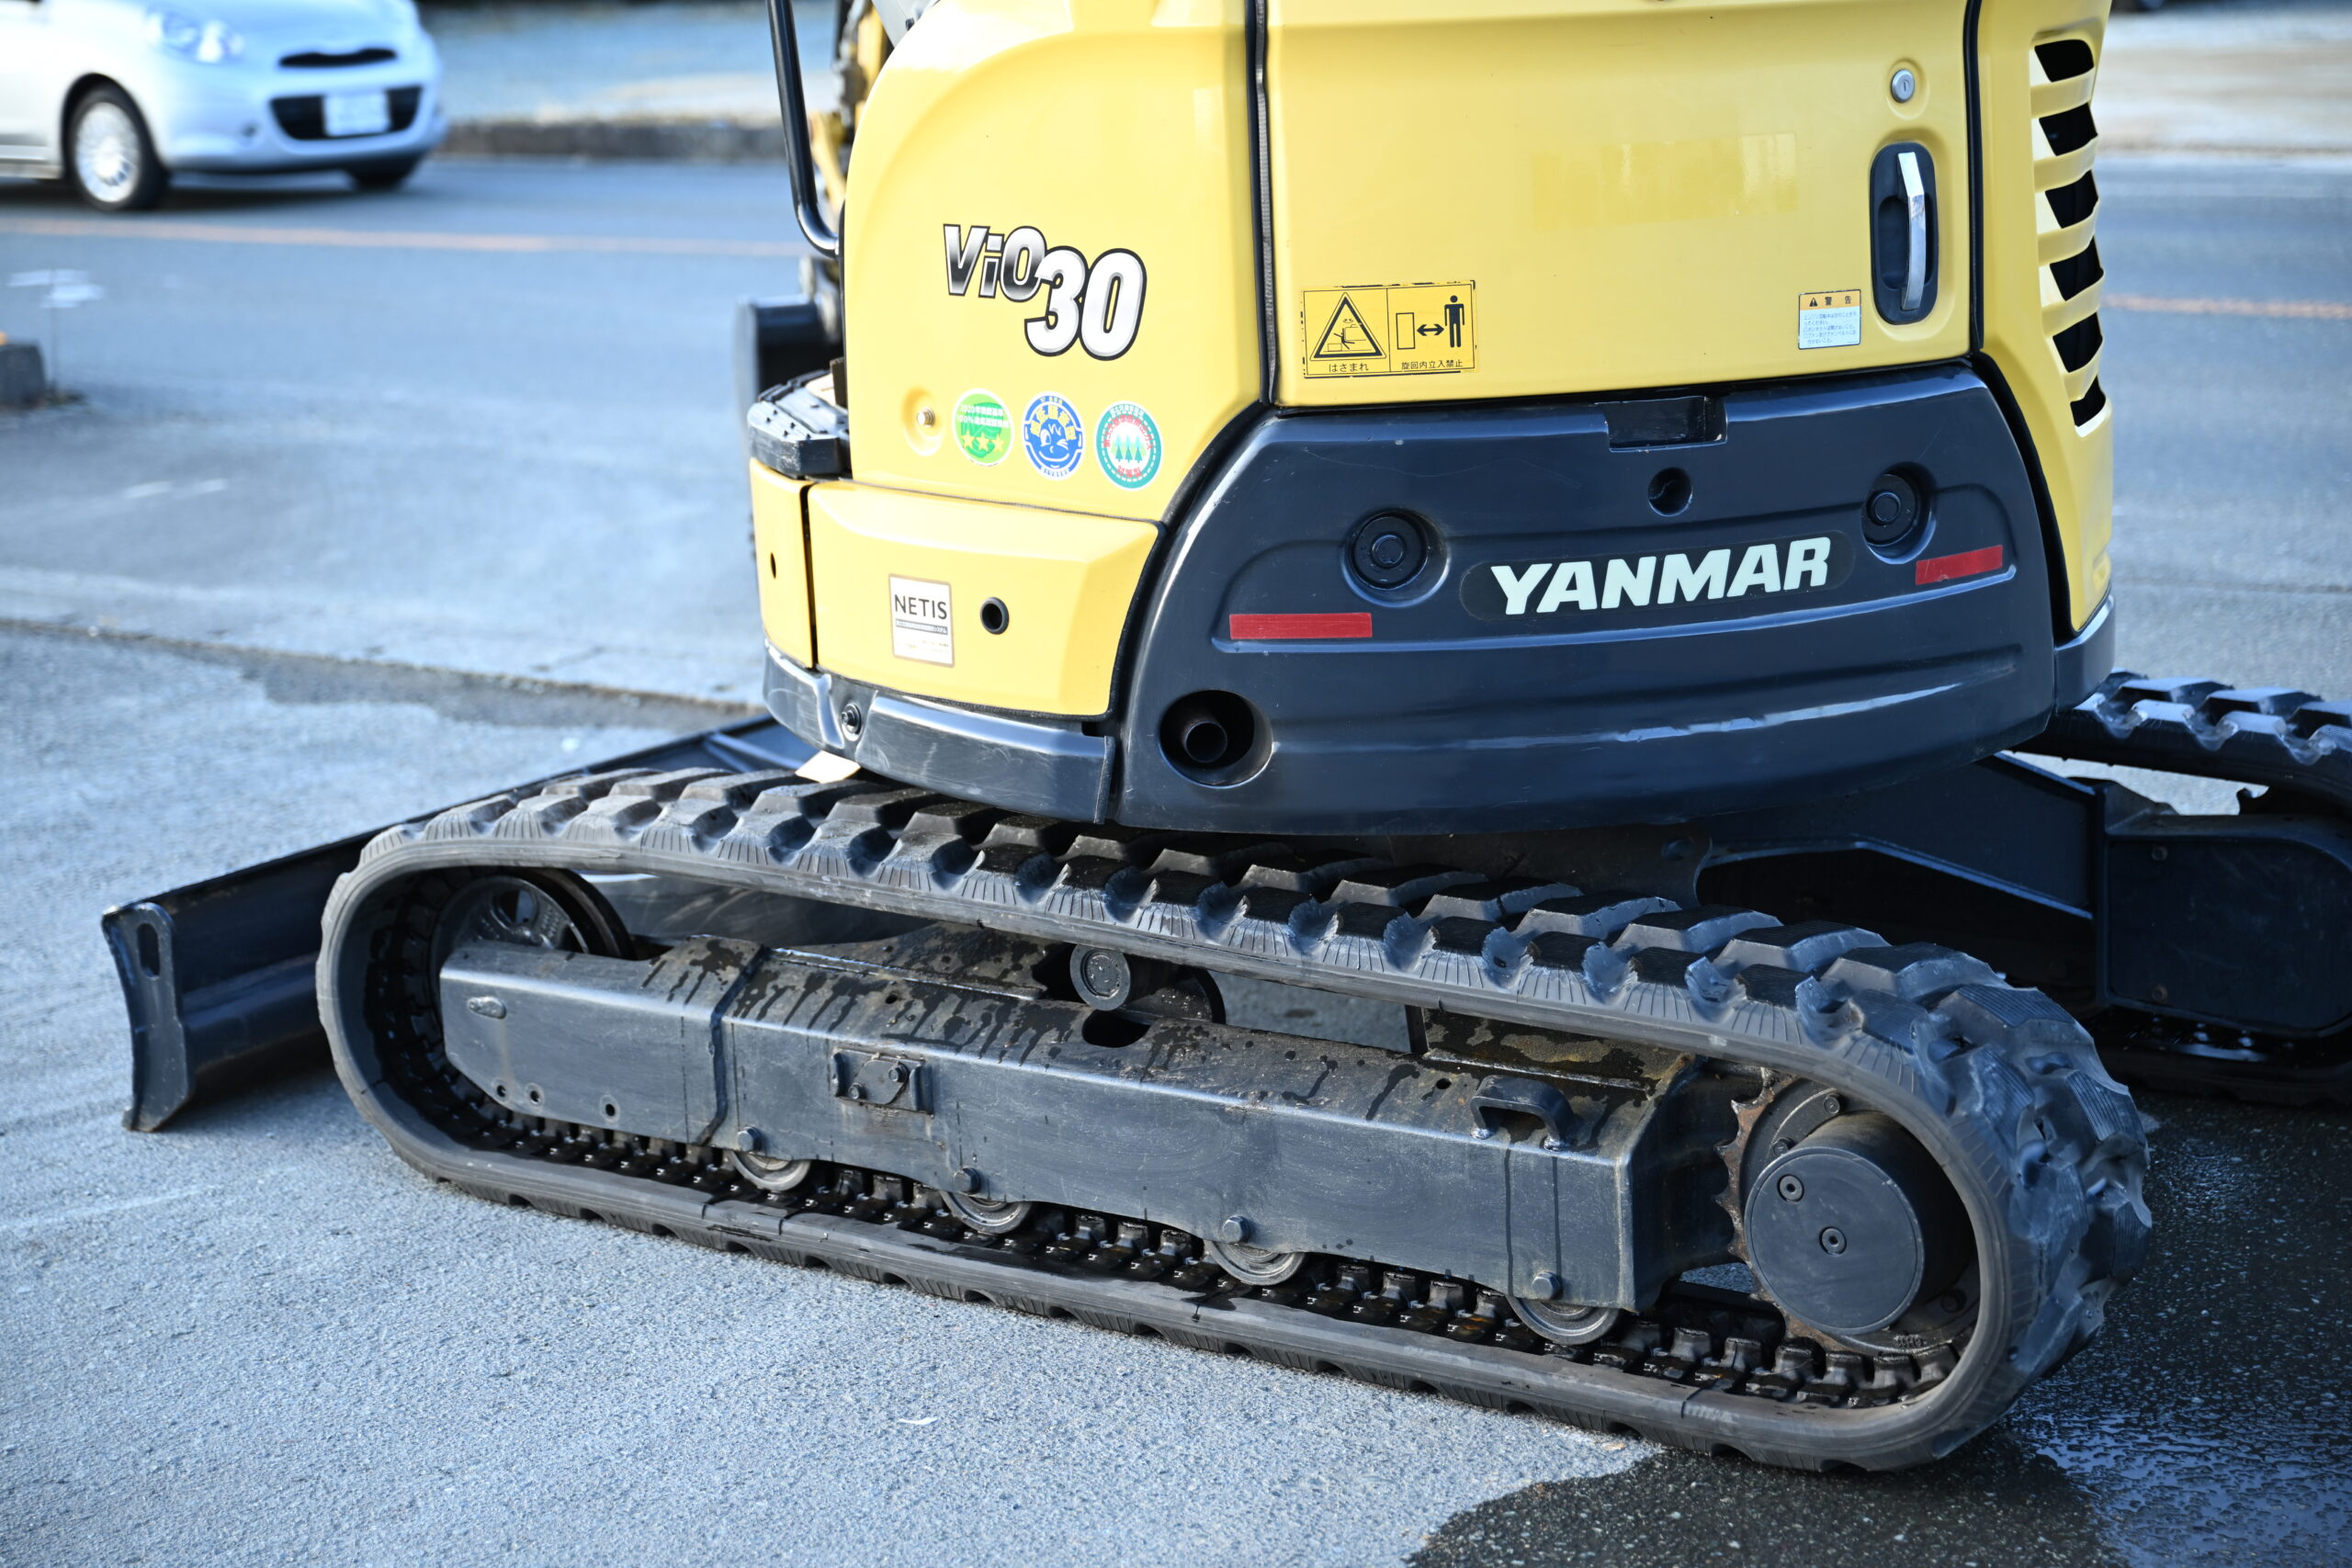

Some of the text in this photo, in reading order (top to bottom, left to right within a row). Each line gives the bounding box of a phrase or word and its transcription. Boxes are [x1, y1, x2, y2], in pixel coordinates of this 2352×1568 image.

[1329, 363, 1370, 373] はさまれ
[1401, 359, 1464, 370] 旋回内立入禁止
[1490, 536, 1831, 615] YANMAR
[894, 593, 948, 620] NETIS
